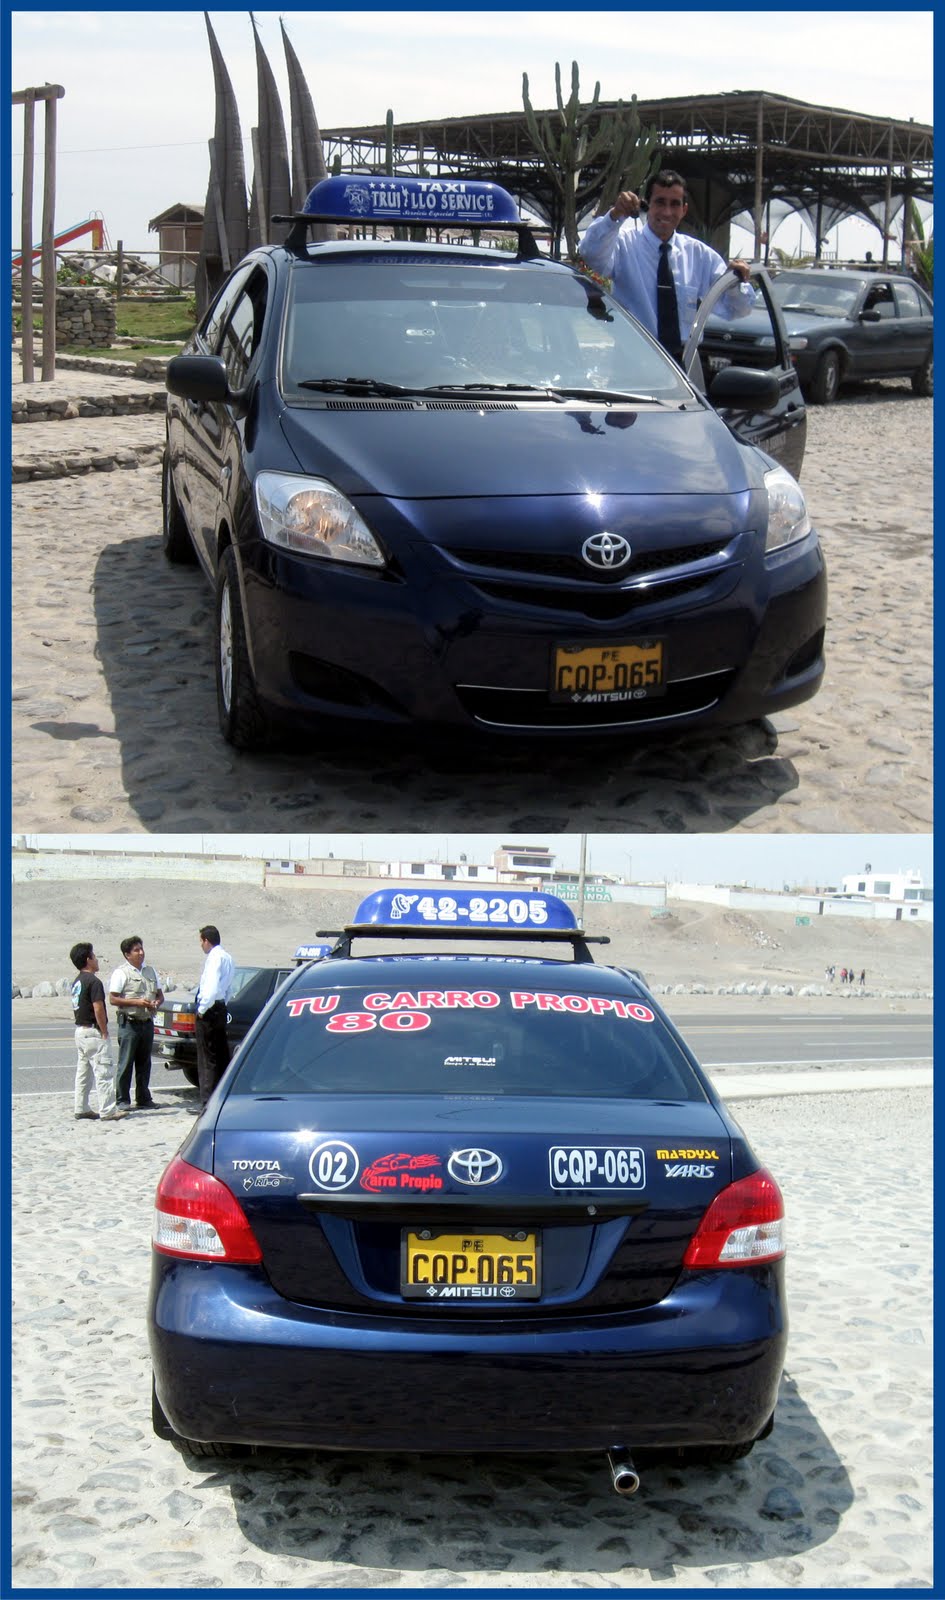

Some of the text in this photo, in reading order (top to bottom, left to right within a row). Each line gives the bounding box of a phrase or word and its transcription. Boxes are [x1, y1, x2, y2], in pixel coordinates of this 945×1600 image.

[417, 182, 466, 192] TAXI
[441, 193, 494, 211] SERVICE
[601, 650, 620, 661] PE
[582, 691, 632, 702] MITSUI
[557, 884, 604, 893] LUHO
[417, 897, 548, 924] 42-2205
[286, 991, 655, 1022] TU CARRO PROPIO
[326, 1011, 431, 1032] 80
[232, 1160, 280, 1170] TOYOTA
[318, 1151, 348, 1183] 02
[553, 1150, 642, 1185] CQP-065
[401, 1173, 443, 1191] Propio
[461, 1240, 484, 1252] PE
[440, 1287, 497, 1297] MITSUI
